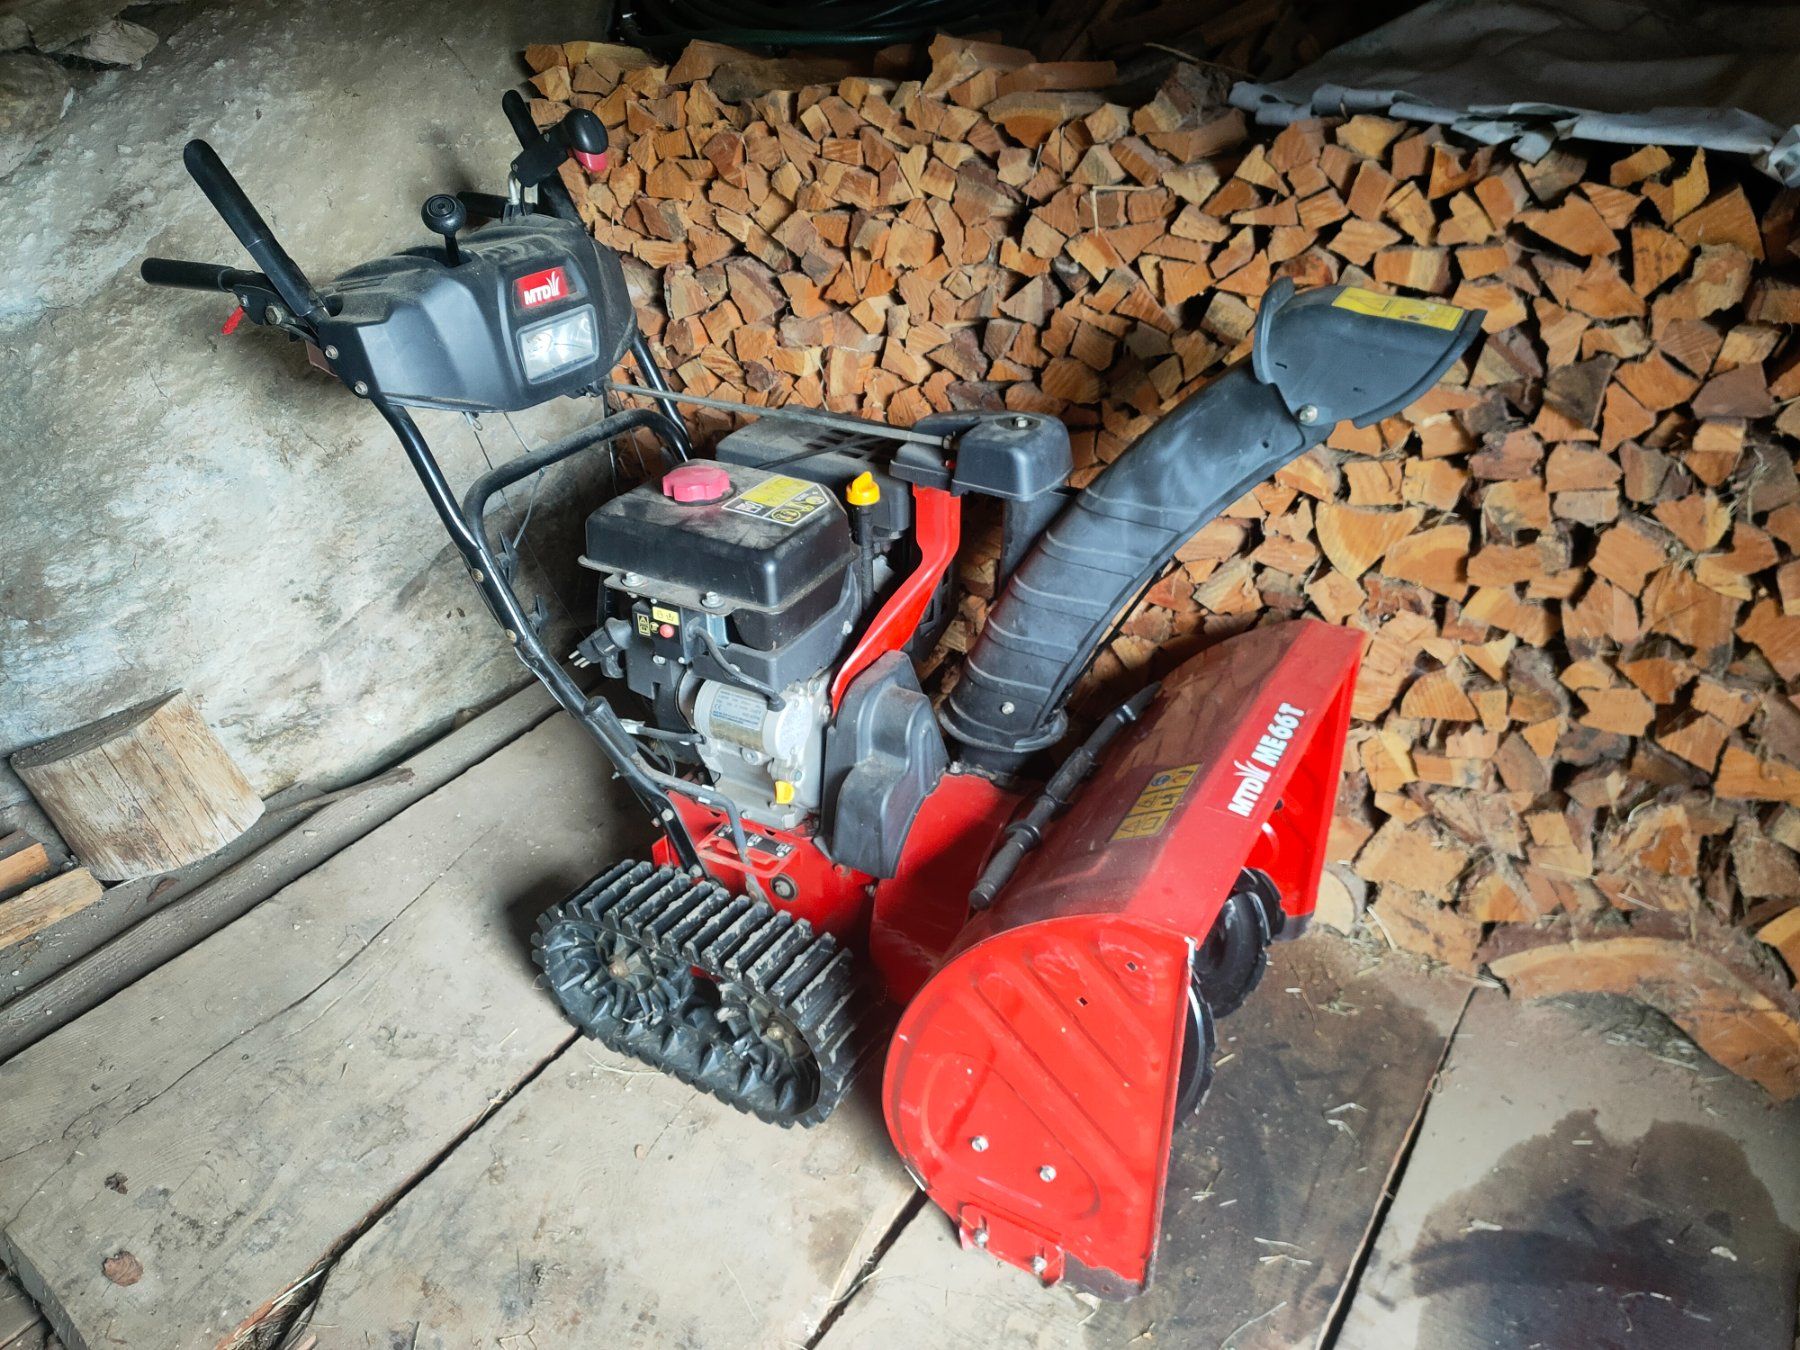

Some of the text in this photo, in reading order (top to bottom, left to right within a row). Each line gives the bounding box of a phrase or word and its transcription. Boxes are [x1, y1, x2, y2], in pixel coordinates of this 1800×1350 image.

[524, 284, 552, 305] MTD
[1227, 702, 1305, 817] MTD ME66T
